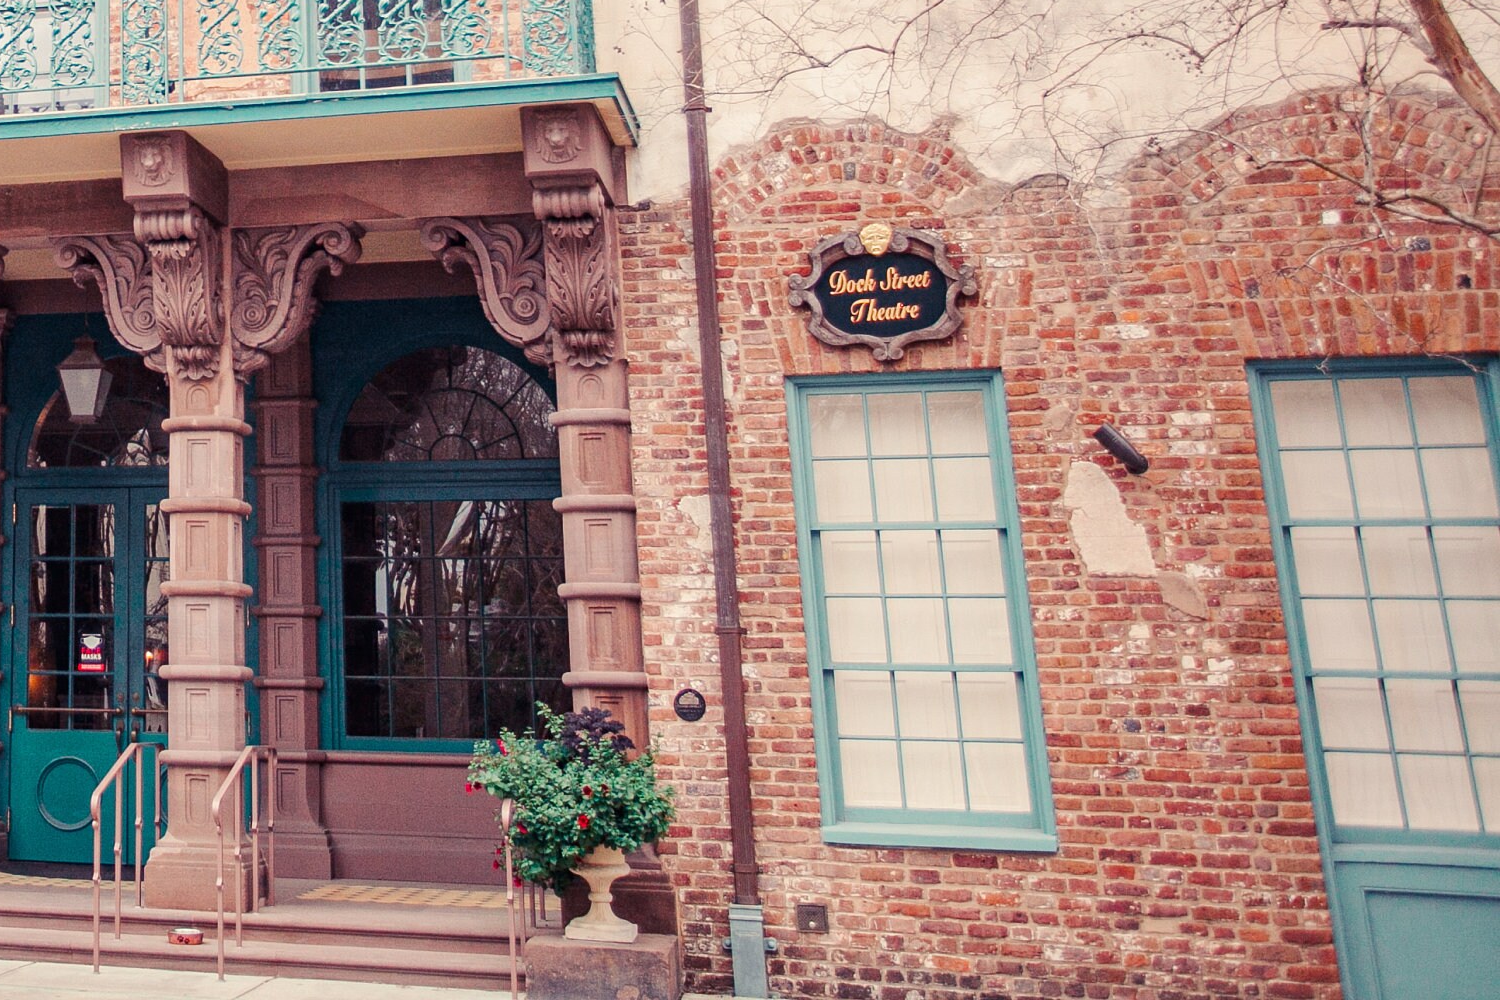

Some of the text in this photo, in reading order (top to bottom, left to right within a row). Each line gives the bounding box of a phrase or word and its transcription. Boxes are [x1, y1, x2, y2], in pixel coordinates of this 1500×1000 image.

[829, 266, 931, 295] Dock Street
[850, 298, 919, 323] Theatre
